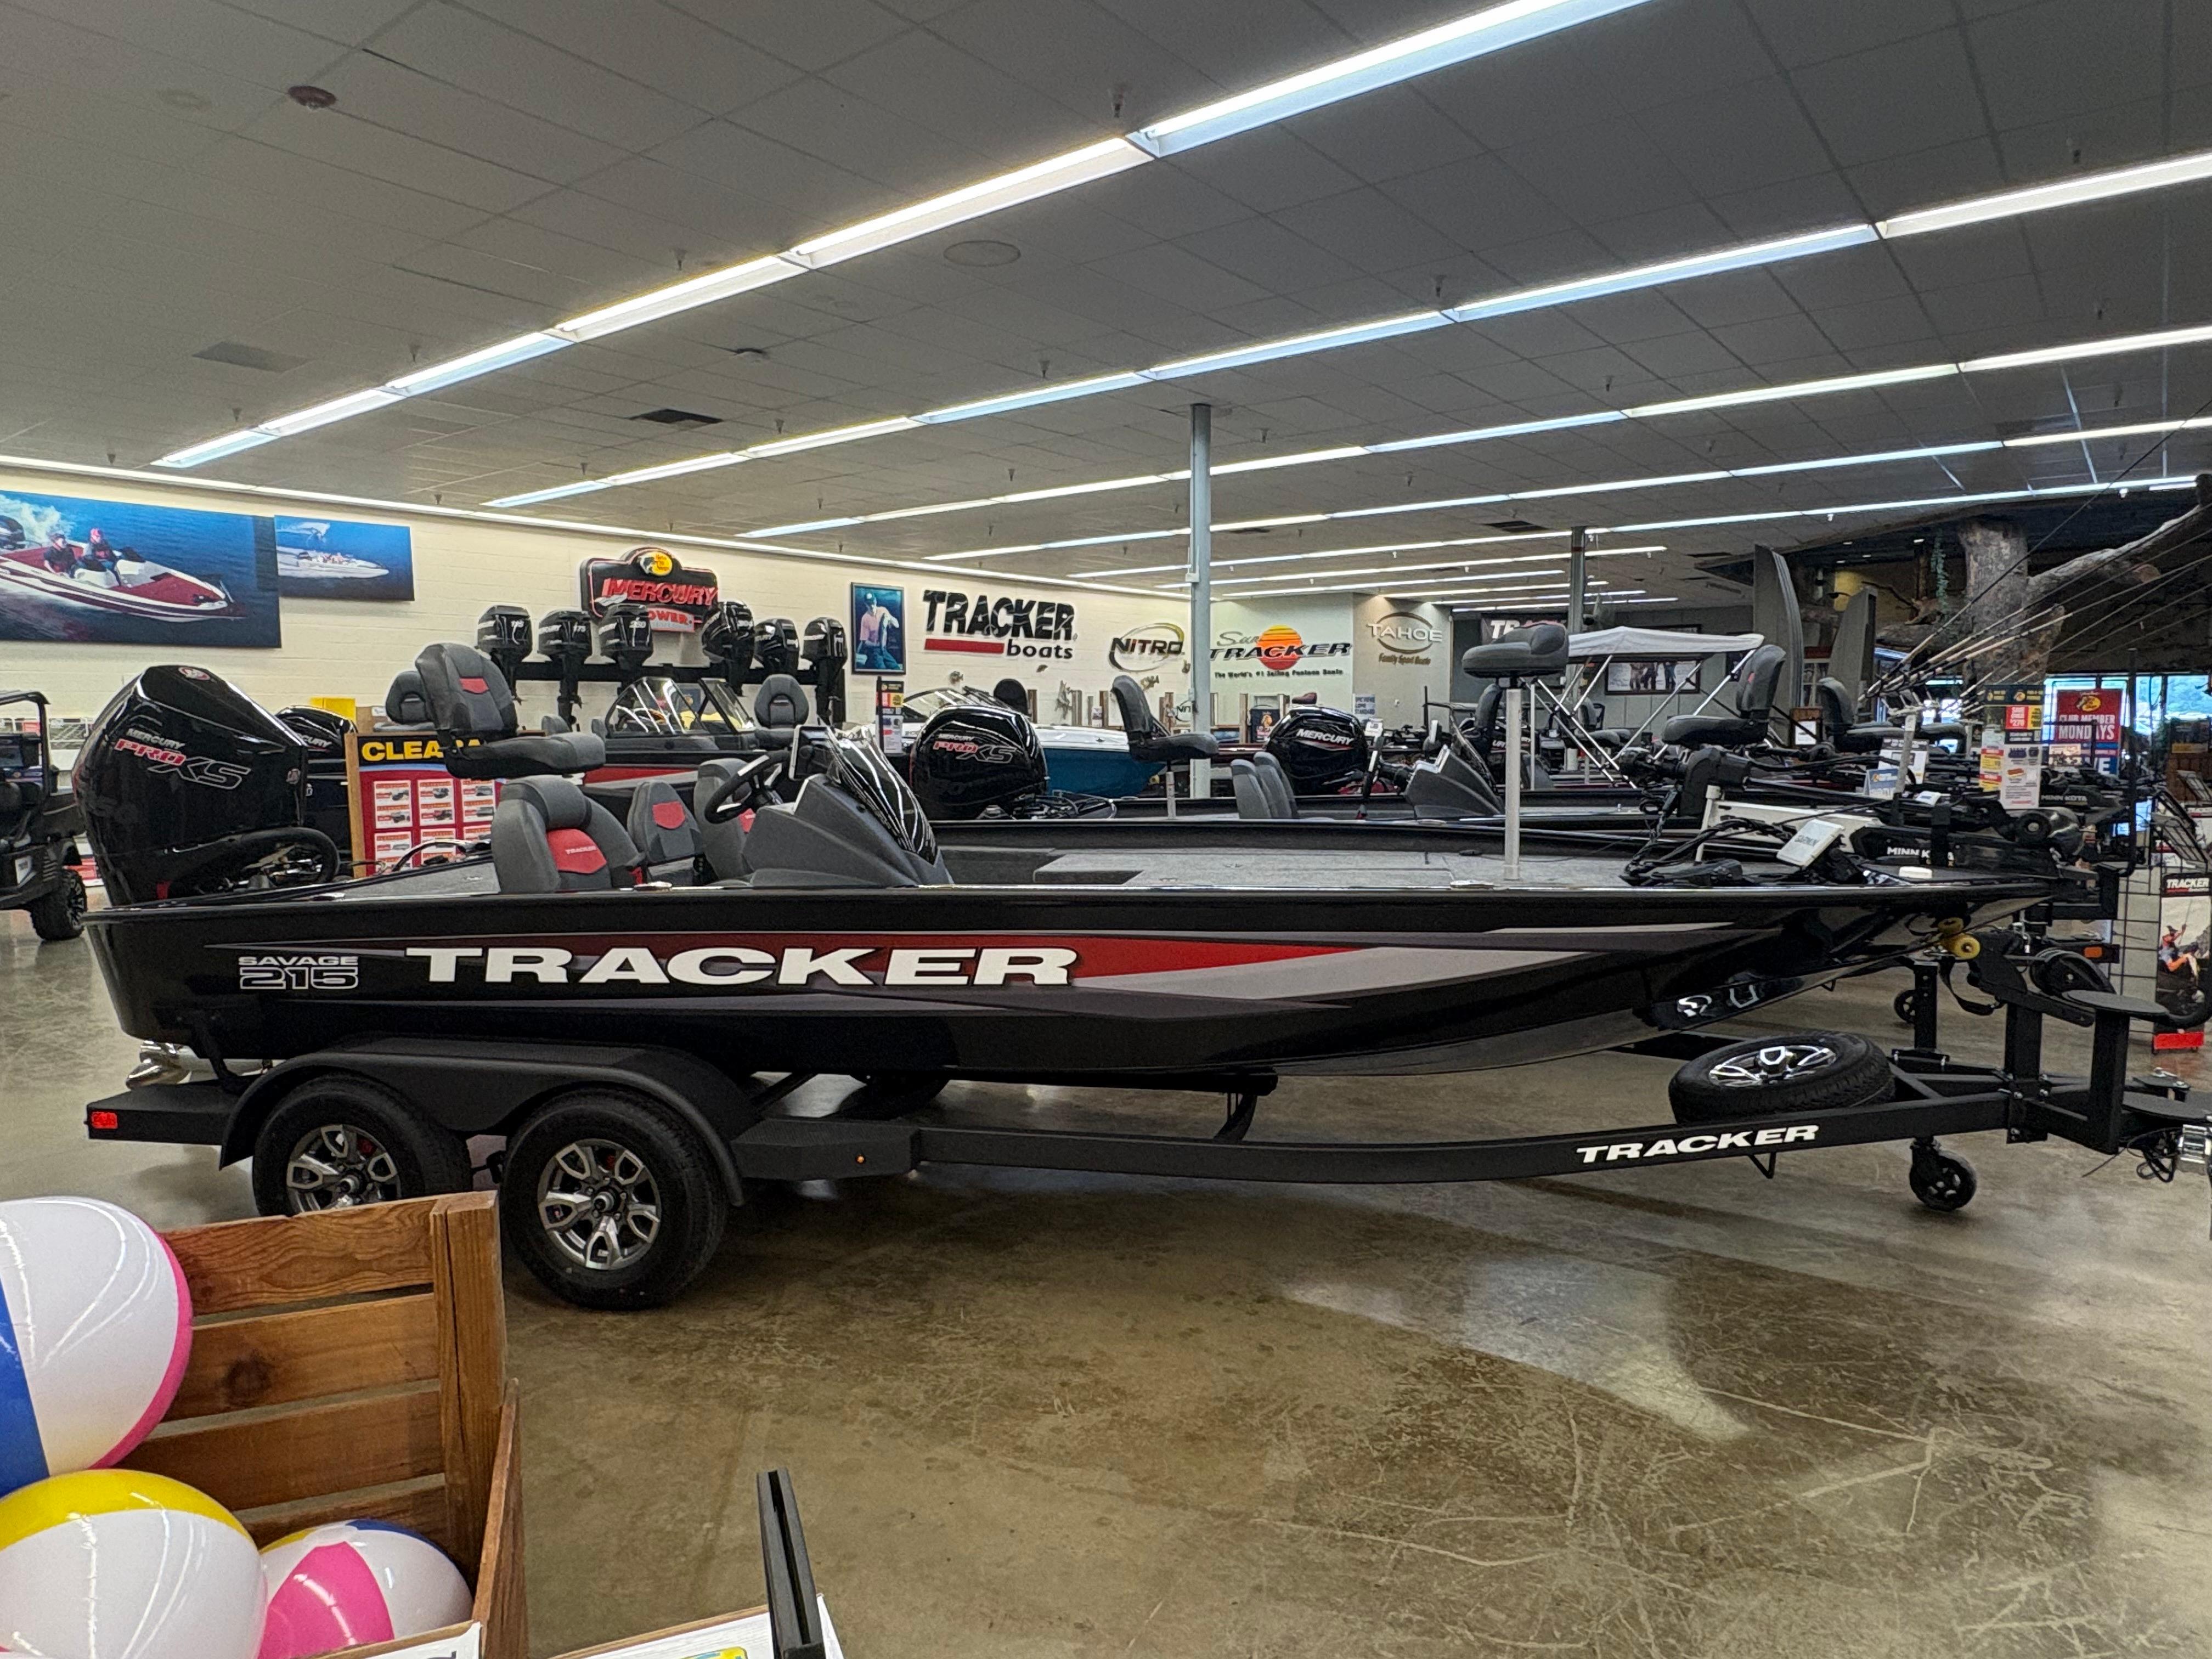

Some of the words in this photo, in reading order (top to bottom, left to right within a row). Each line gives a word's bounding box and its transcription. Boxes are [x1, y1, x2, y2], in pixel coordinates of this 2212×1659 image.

[602, 578, 718, 606] MERCURY
[923, 590, 1074, 641] TRACKER
[1217, 631, 1260, 646] Sun
[1365, 623, 1443, 642] TAHOE
[1007, 639, 1073, 659] boats
[1110, 637, 1184, 654] NITRO
[1210, 642, 1352, 661] TRACKER
[126, 727, 185, 749] MERCURY
[933, 741, 979, 753] PRO
[1296, 729, 1355, 745] MERCURY
[114, 738, 187, 766] PRO
[956, 744, 1017, 764] XS
[147, 756, 251, 789] XS
[1887, 847, 1920, 856] MINN
[1921, 849, 1954, 860] KA
[2166, 878, 2210, 888] TRACKER
[239, 956, 358, 966] SAVAGE
[406, 947, 1077, 985] TRACKER
[239, 967, 358, 990] 215
[1577, 1125, 1819, 1163] TRACKER
